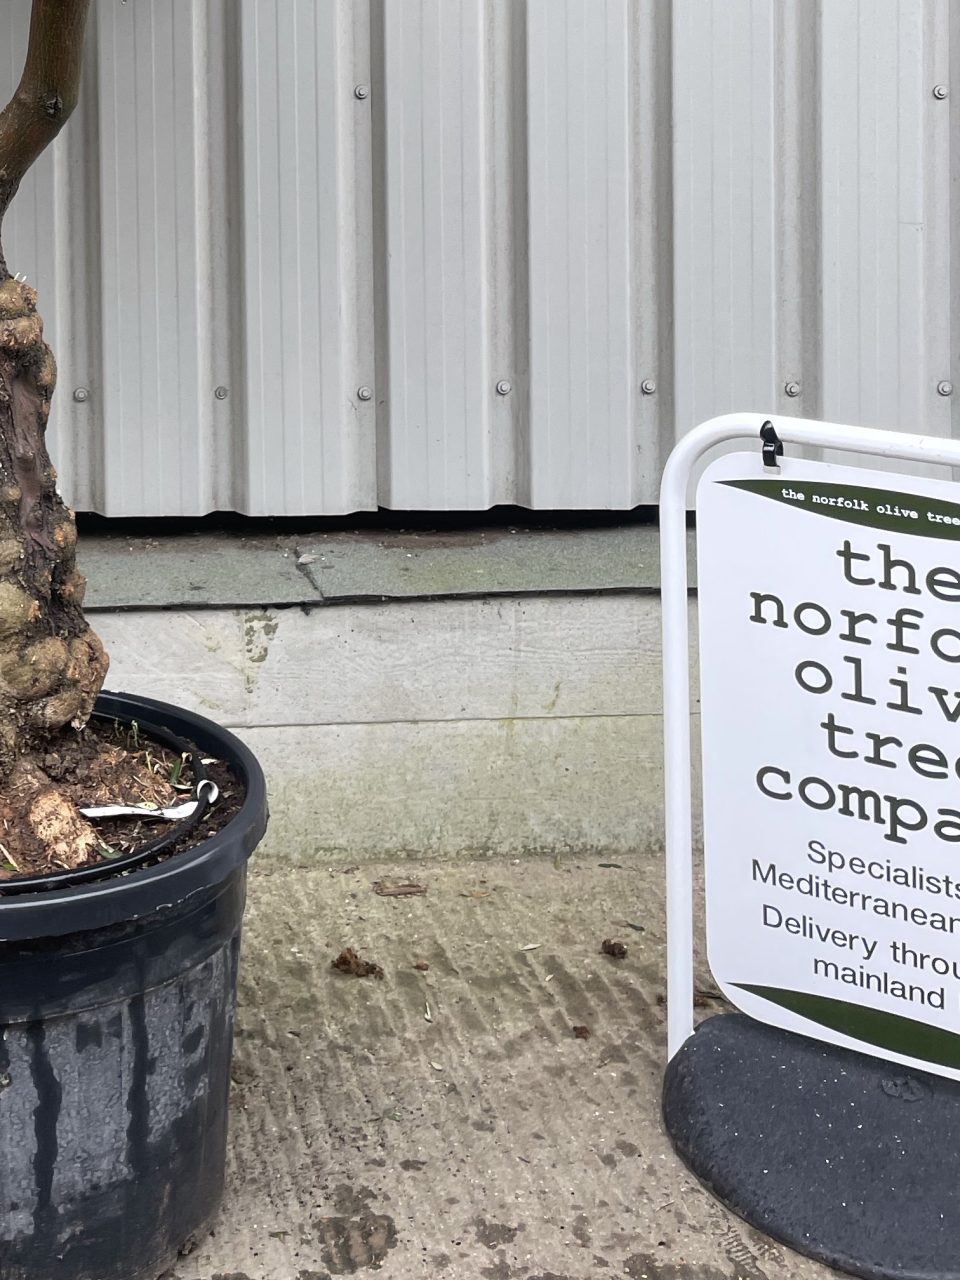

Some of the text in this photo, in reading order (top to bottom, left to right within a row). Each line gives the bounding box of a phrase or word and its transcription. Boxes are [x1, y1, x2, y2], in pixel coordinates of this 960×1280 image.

[781, 487, 805, 501] the
[812, 492, 869, 511] norfolk
[876, 504, 919, 520] olive
[835, 539, 960, 602] the
[749, 591, 960, 663] norfo
[820, 712, 960, 780] tre
[762, 903, 878, 960] Delivery
[813, 957, 945, 1010] mainland
